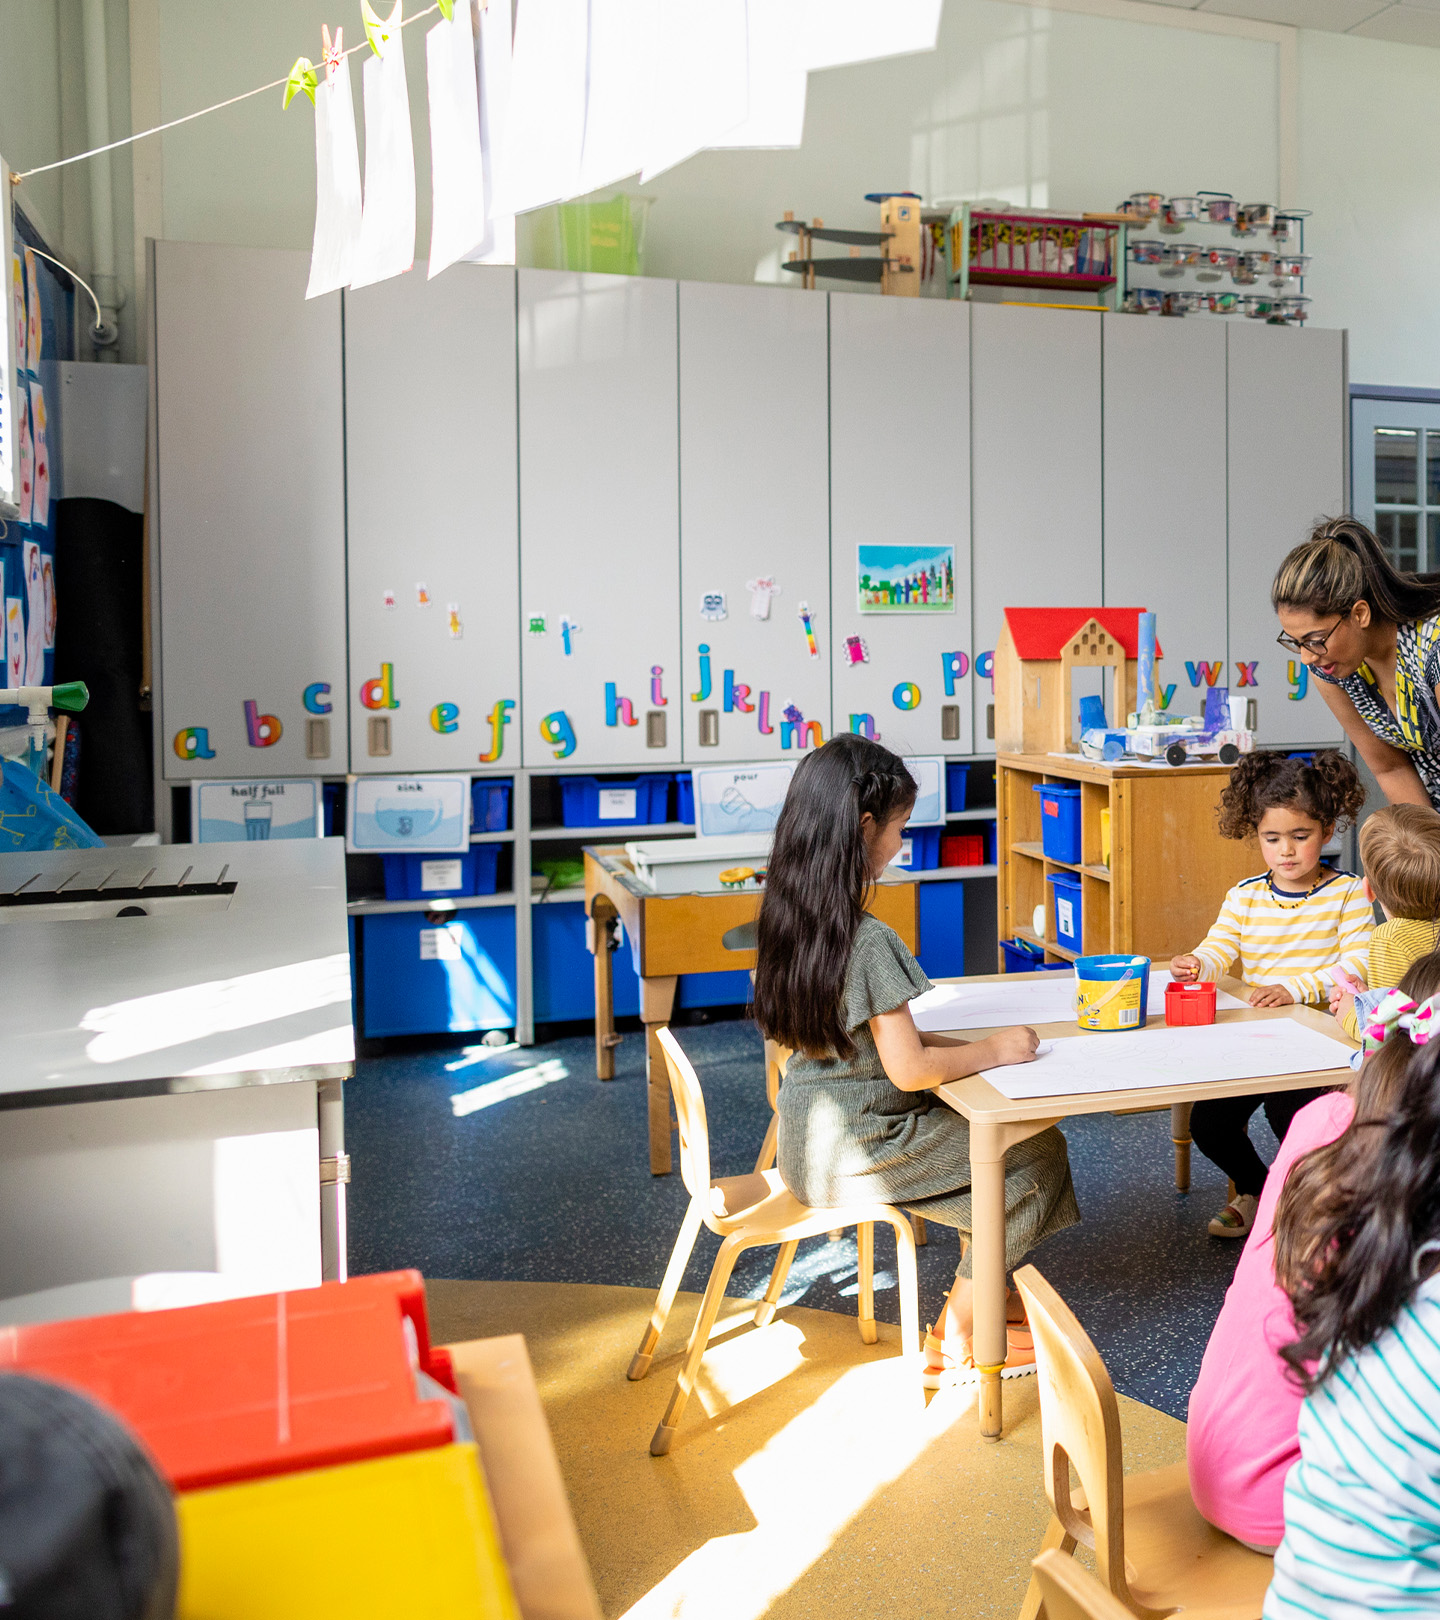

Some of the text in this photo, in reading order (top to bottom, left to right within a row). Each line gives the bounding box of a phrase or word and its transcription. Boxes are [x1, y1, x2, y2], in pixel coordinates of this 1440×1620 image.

[1184, 660, 1223, 688] w
[1235, 661, 1259, 687] x
[1287, 660, 1309, 701] y
[173, 726, 217, 761] a
[244, 700, 283, 748] b
[302, 682, 333, 715] c
[360, 662, 400, 710] d
[429, 702, 460, 734] e
[479, 699, 516, 763] f
[539, 710, 577, 760] g
[604, 682, 639, 727] h
[651, 665, 668, 706] i
[690, 643, 712, 702] j
[723, 669, 755, 713] k
[758, 691, 774, 735] l
[780, 721, 828, 750] m
[849, 713, 881, 741] n
[892, 682, 921, 711] o
[941, 651, 970, 697] p
[396, 782, 424, 792] sink
[733, 773, 759, 785] pour
[231, 783, 285, 800] half full
